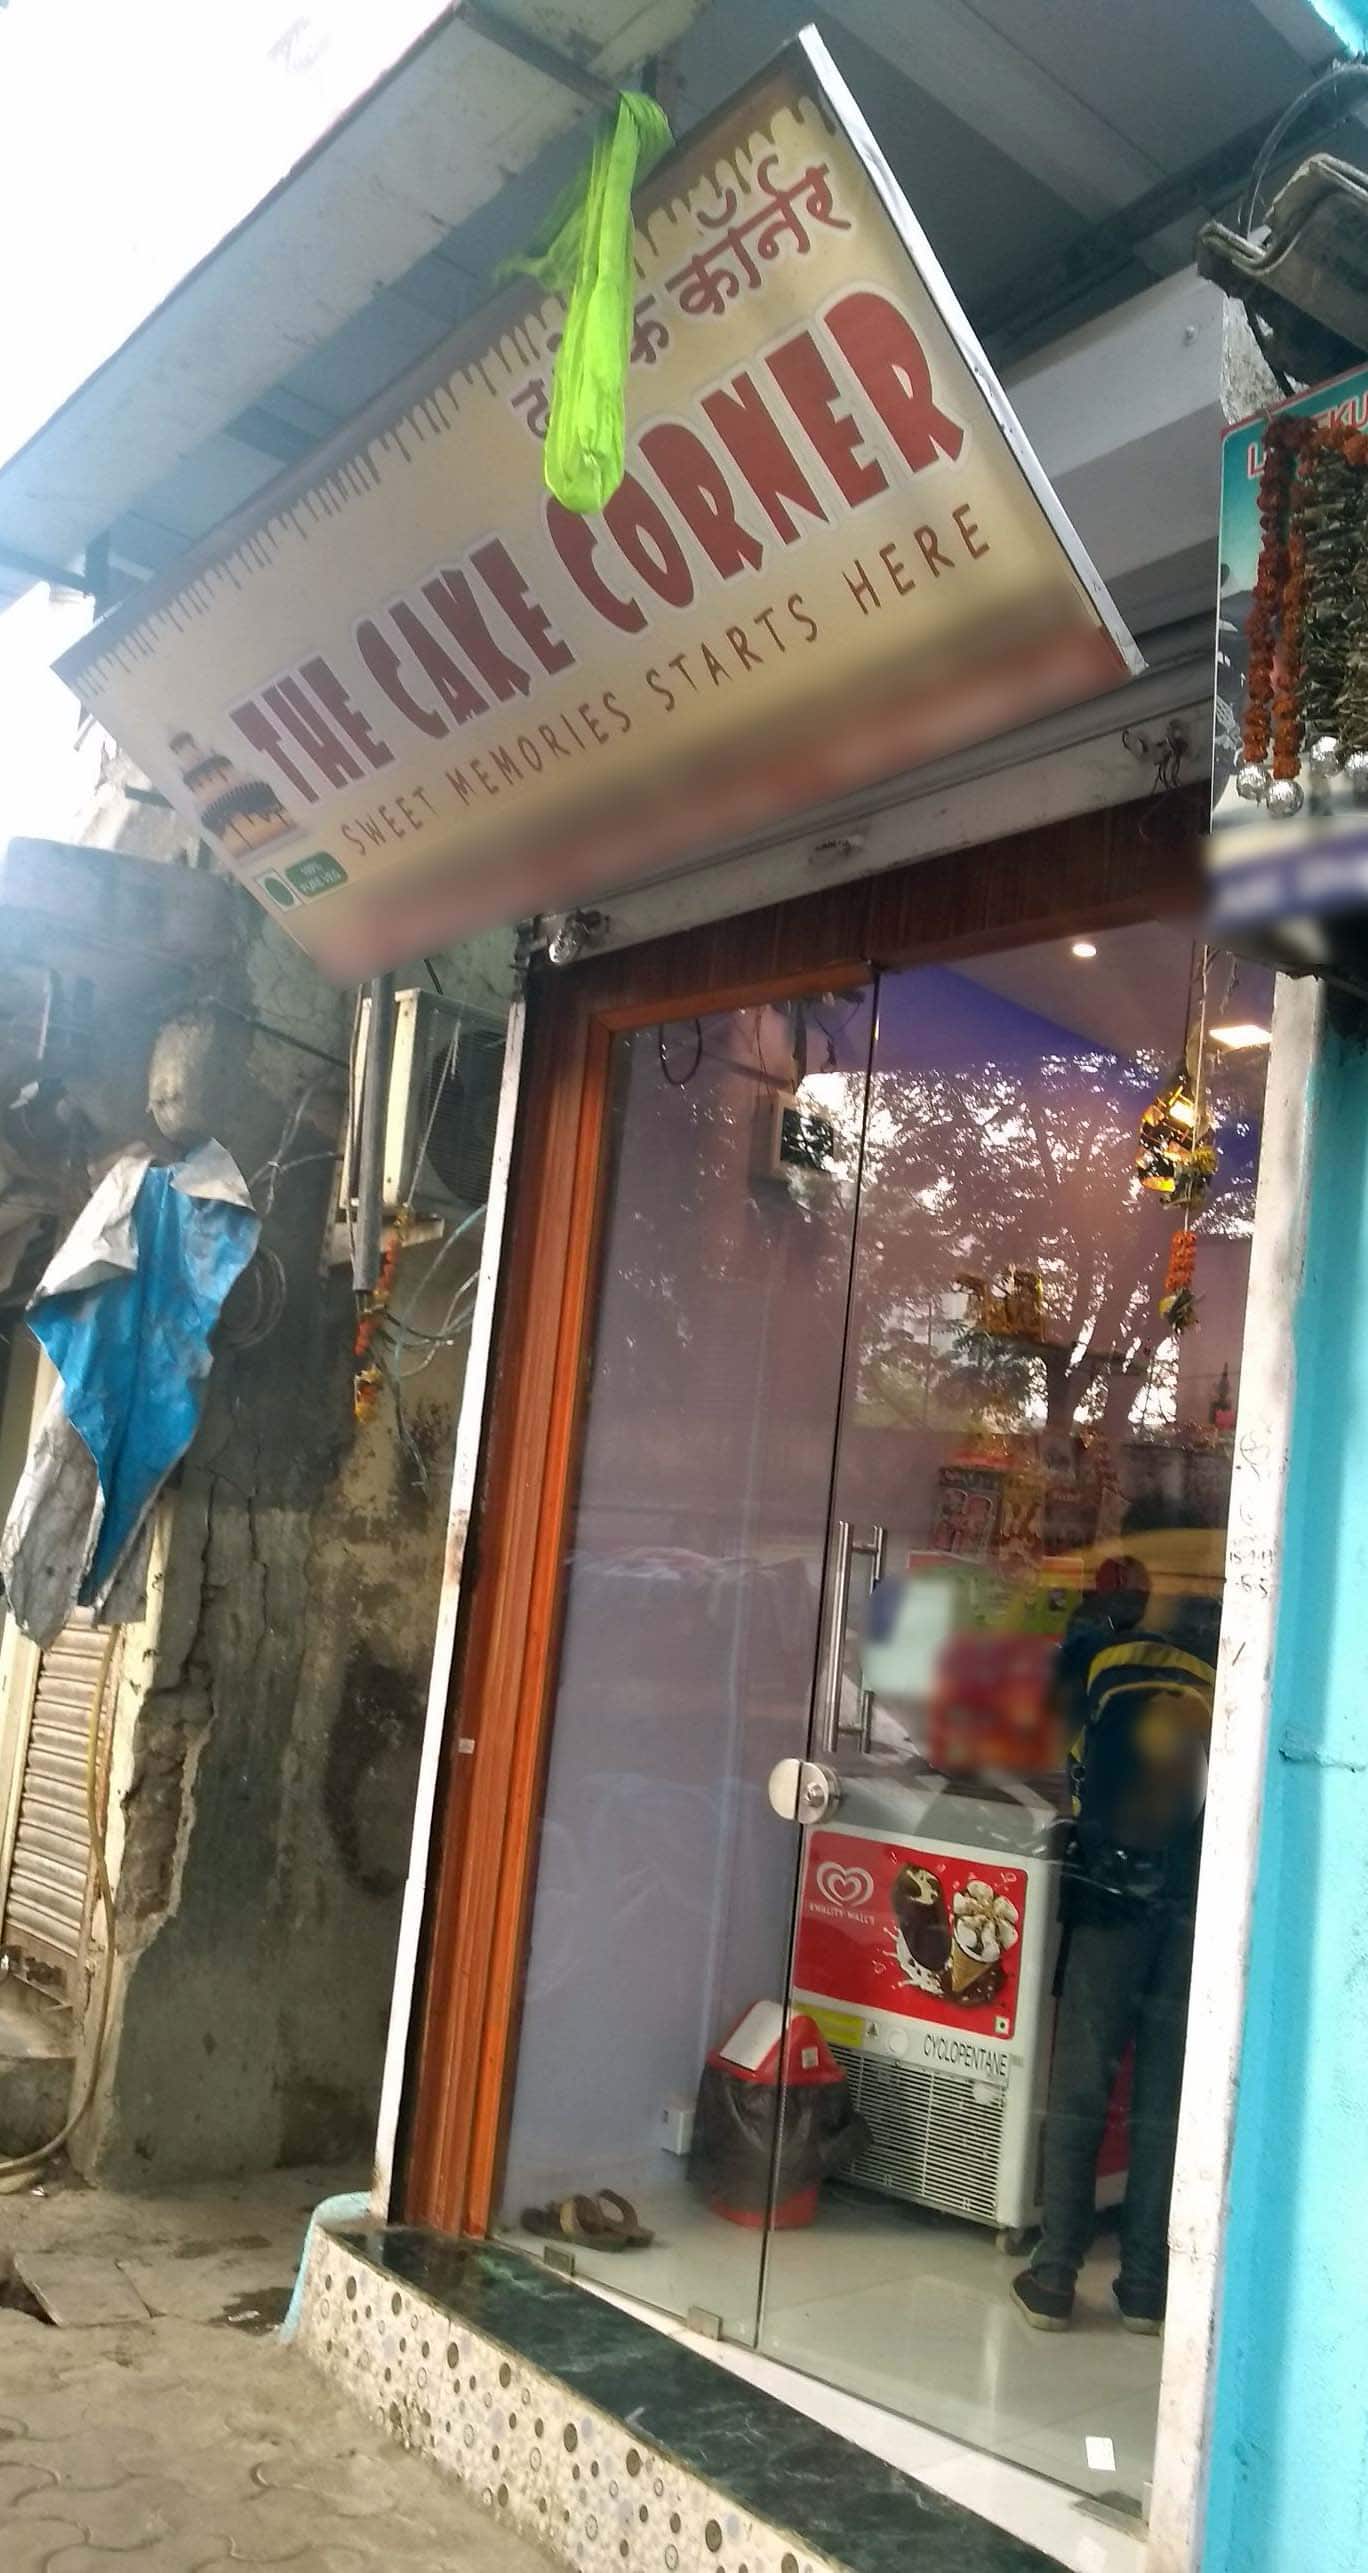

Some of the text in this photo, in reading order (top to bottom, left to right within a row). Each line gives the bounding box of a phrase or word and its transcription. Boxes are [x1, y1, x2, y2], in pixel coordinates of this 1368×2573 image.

[229, 291, 965, 804] THE CAKE CORNER
[341, 503, 991, 856] SWEET MEMORIES STARTS HERE
[922, 2033, 1009, 2077] CYCLOPENTANE
